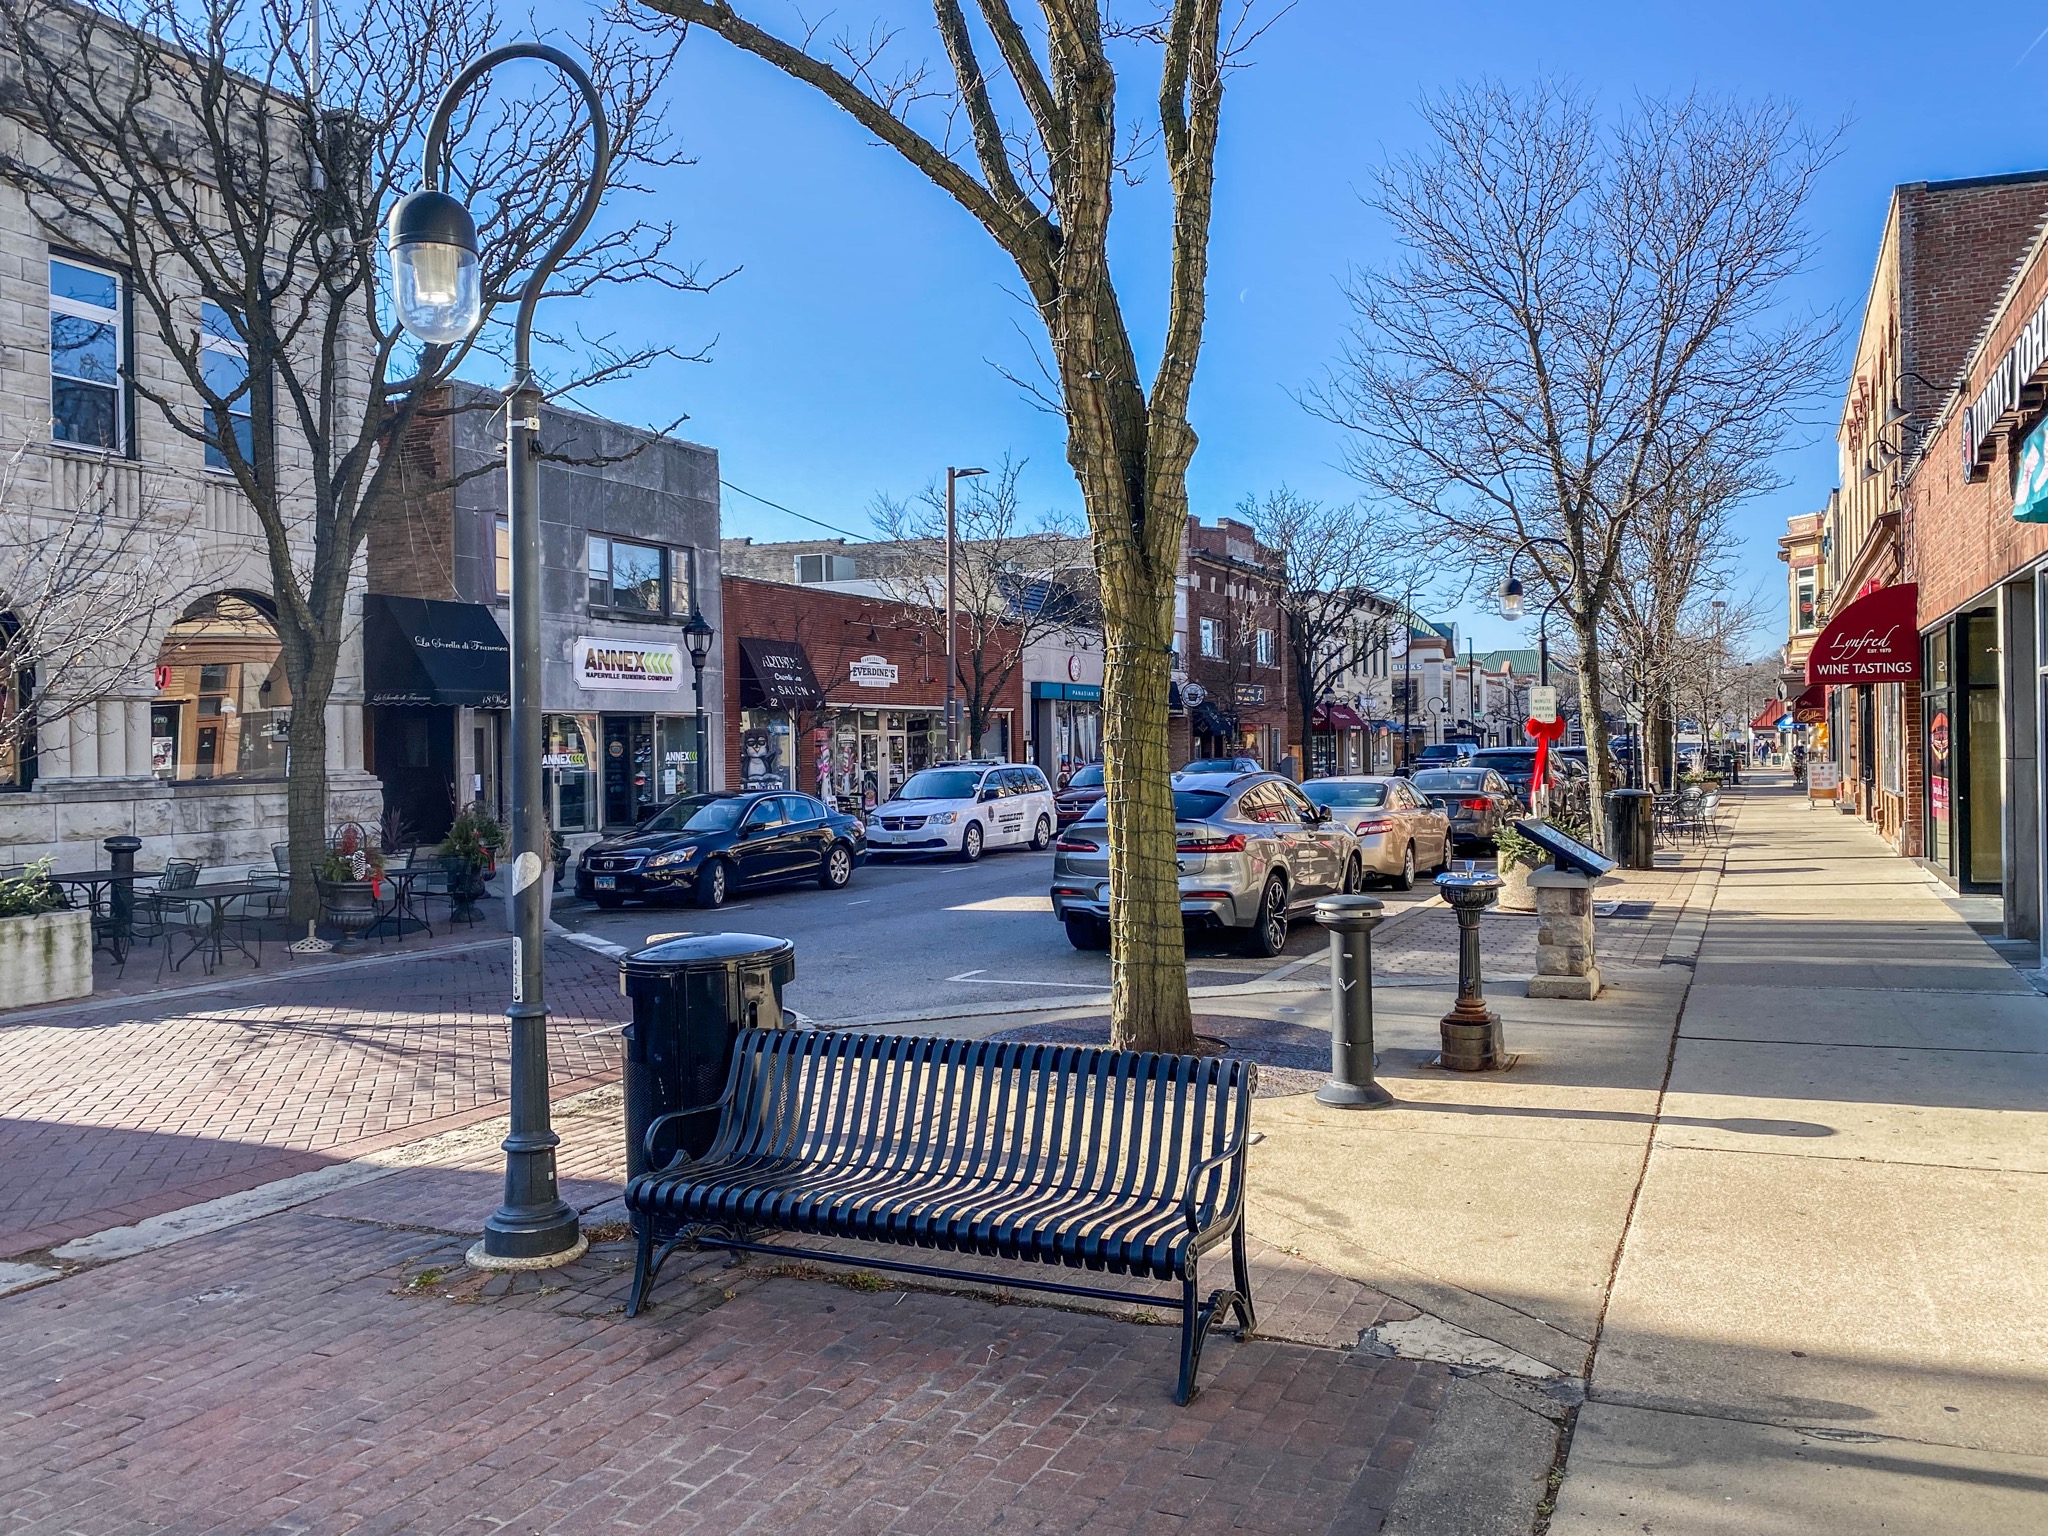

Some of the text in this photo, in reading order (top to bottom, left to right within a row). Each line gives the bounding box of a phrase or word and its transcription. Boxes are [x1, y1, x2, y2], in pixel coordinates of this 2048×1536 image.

[1971, 294, 2048, 466] JIMMY JOH
[1830, 625, 1899, 660] Lynfred
[584, 648, 646, 672] ANNEX
[853, 666, 895, 678] EVERDINE'S
[1817, 662, 1912, 675] WINE TASTINGS
[586, 672, 620, 680] NAPERVILLE
[647, 674, 673, 682] COMPANY
[777, 685, 809, 696] SALON
[770, 698, 778, 707] 22
[542, 754, 571, 765] ANNEX
[665, 752, 689, 762] ANNEX
